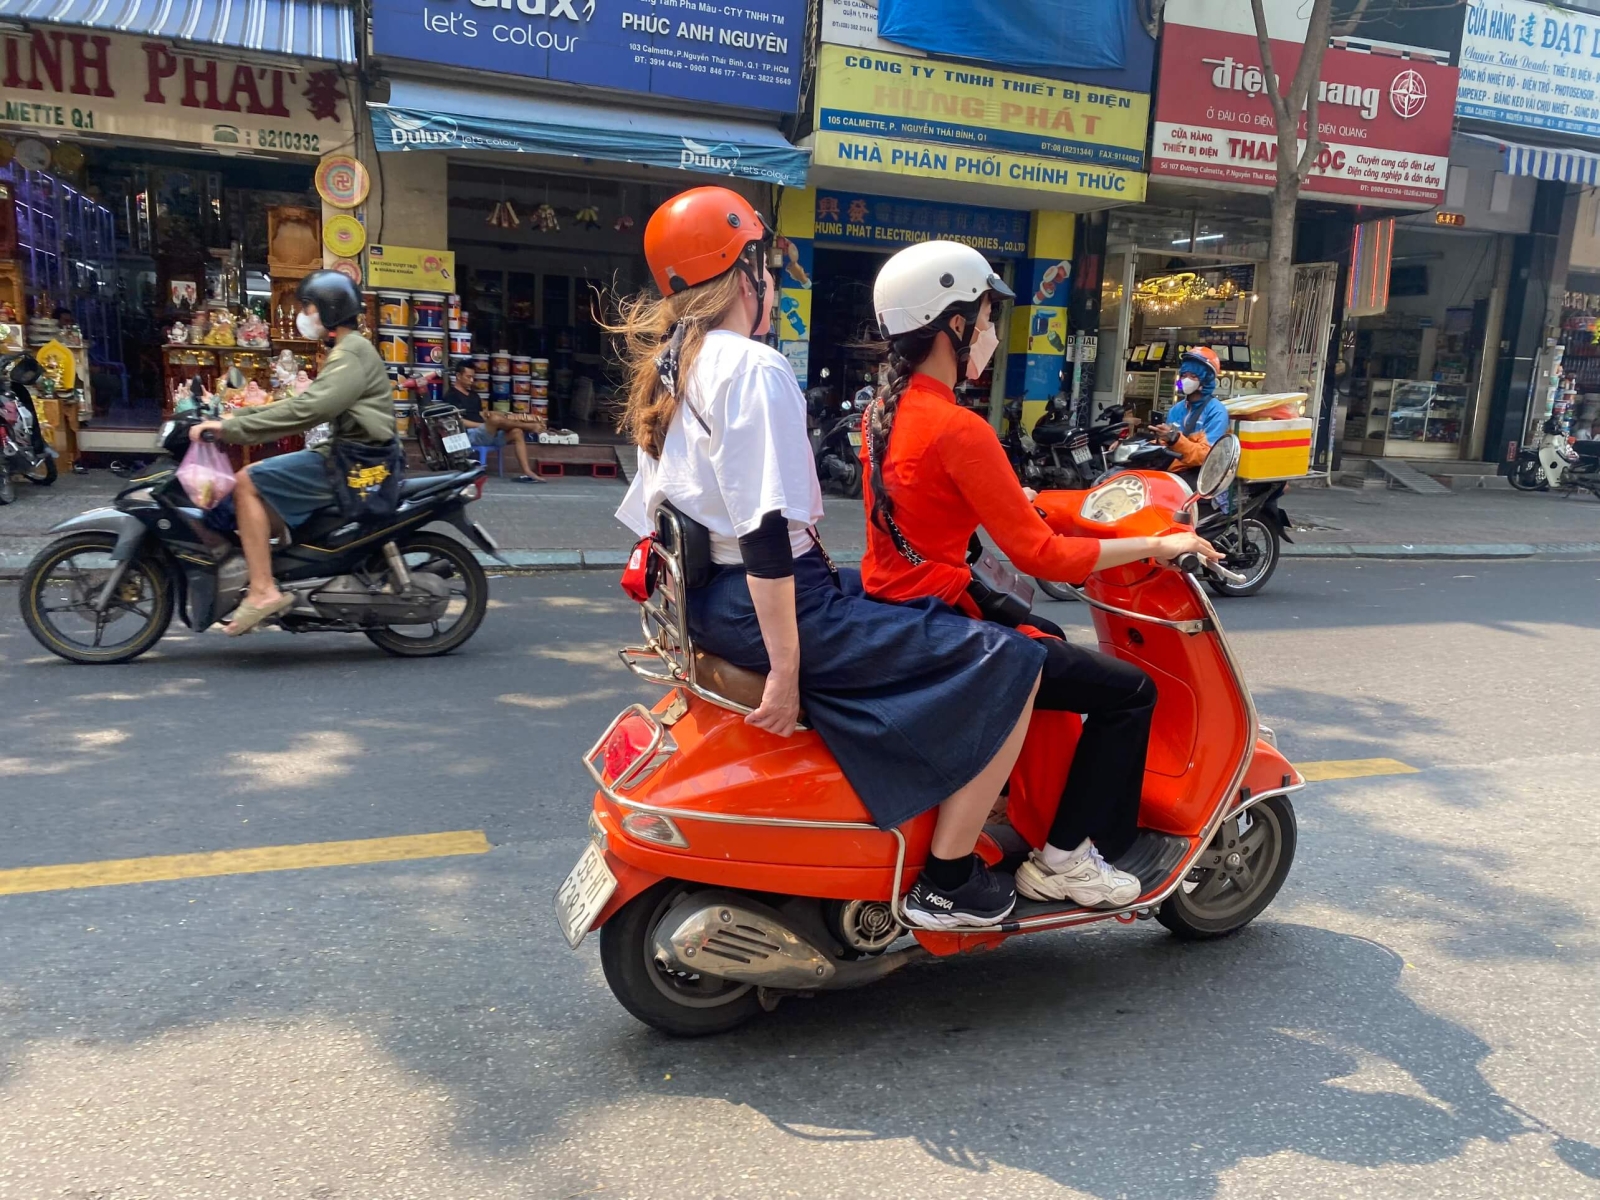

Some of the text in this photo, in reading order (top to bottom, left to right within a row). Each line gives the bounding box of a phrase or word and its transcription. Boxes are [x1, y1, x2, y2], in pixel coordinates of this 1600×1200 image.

[723, 6, 743, 18] CTY
[745, 10, 769, 22] TNHH
[771, 14, 785, 25] TM
[424, 7, 478, 38] let's
[492, 24, 579, 52] colour
[622, 12, 671, 36] PHÚC
[676, 22, 714, 43] ANH
[1489, 3, 1516, 42] HÀNG
[1541, 17, 1587, 58] ĐẠT
[629, 42, 641, 51] 103
[649, 58, 665, 66] 3914
[667, 61, 682, 69] 4416
[709, 67, 722, 75] 846
[724, 69, 736, 77] 177
[845, 55, 1131, 108] CÔNG TY TNHH THIẾT BỊ ĐIỆN
[1554, 84, 1595, 101] PHOTOSENSOR
[1292, 80, 1381, 120] ang
[71, 108, 94, 129] Q.1
[827, 115, 841, 125] 105
[842, 117, 888, 131] CALMETTE,
[889, 123, 897, 131] P.
[901, 122, 934, 135] NGUYỄN
[936, 127, 954, 138] THÁI
[955, 130, 976, 141] BÌNH,
[1000, 102, 1101, 135] PHÁT
[1206, 106, 1215, 119] Ở
[1217, 109, 1236, 121] ĐÂU
[1238, 112, 1251, 124] CÓ
[1339, 126, 1368, 139] QUANG
[258, 128, 320, 152] 8210332
[391, 128, 452, 145] Dulux
[486, 138, 521, 147] colour
[1171, 127, 1213, 142] CỬA HÀNG
[1162, 141, 1218, 159] THIẾT BỊ ĐIỆN
[1228, 137, 1298, 167] THA
[681, 149, 732, 170] Dulux
[760, 168, 789, 181] colour
[838, 142, 1126, 193] NHÀ PHÂN PHỐI CHÍNH THỨC
[1356, 154, 1380, 167] Chuyên
[1381, 158, 1396, 169] cung
[1410, 160, 1422, 170] đèn
[1423, 162, 1436, 172] Led
[1347, 165, 1362, 177] Điện
[1363, 168, 1379, 180] công
[1403, 172, 1410, 181] &
[1425, 175, 1440, 187] dụng
[814, 220, 843, 236] HUNG
[846, 223, 872, 239] PHAT
[875, 226, 931, 243] ELECTRICAL
[925, 892, 954, 911] HOKA
